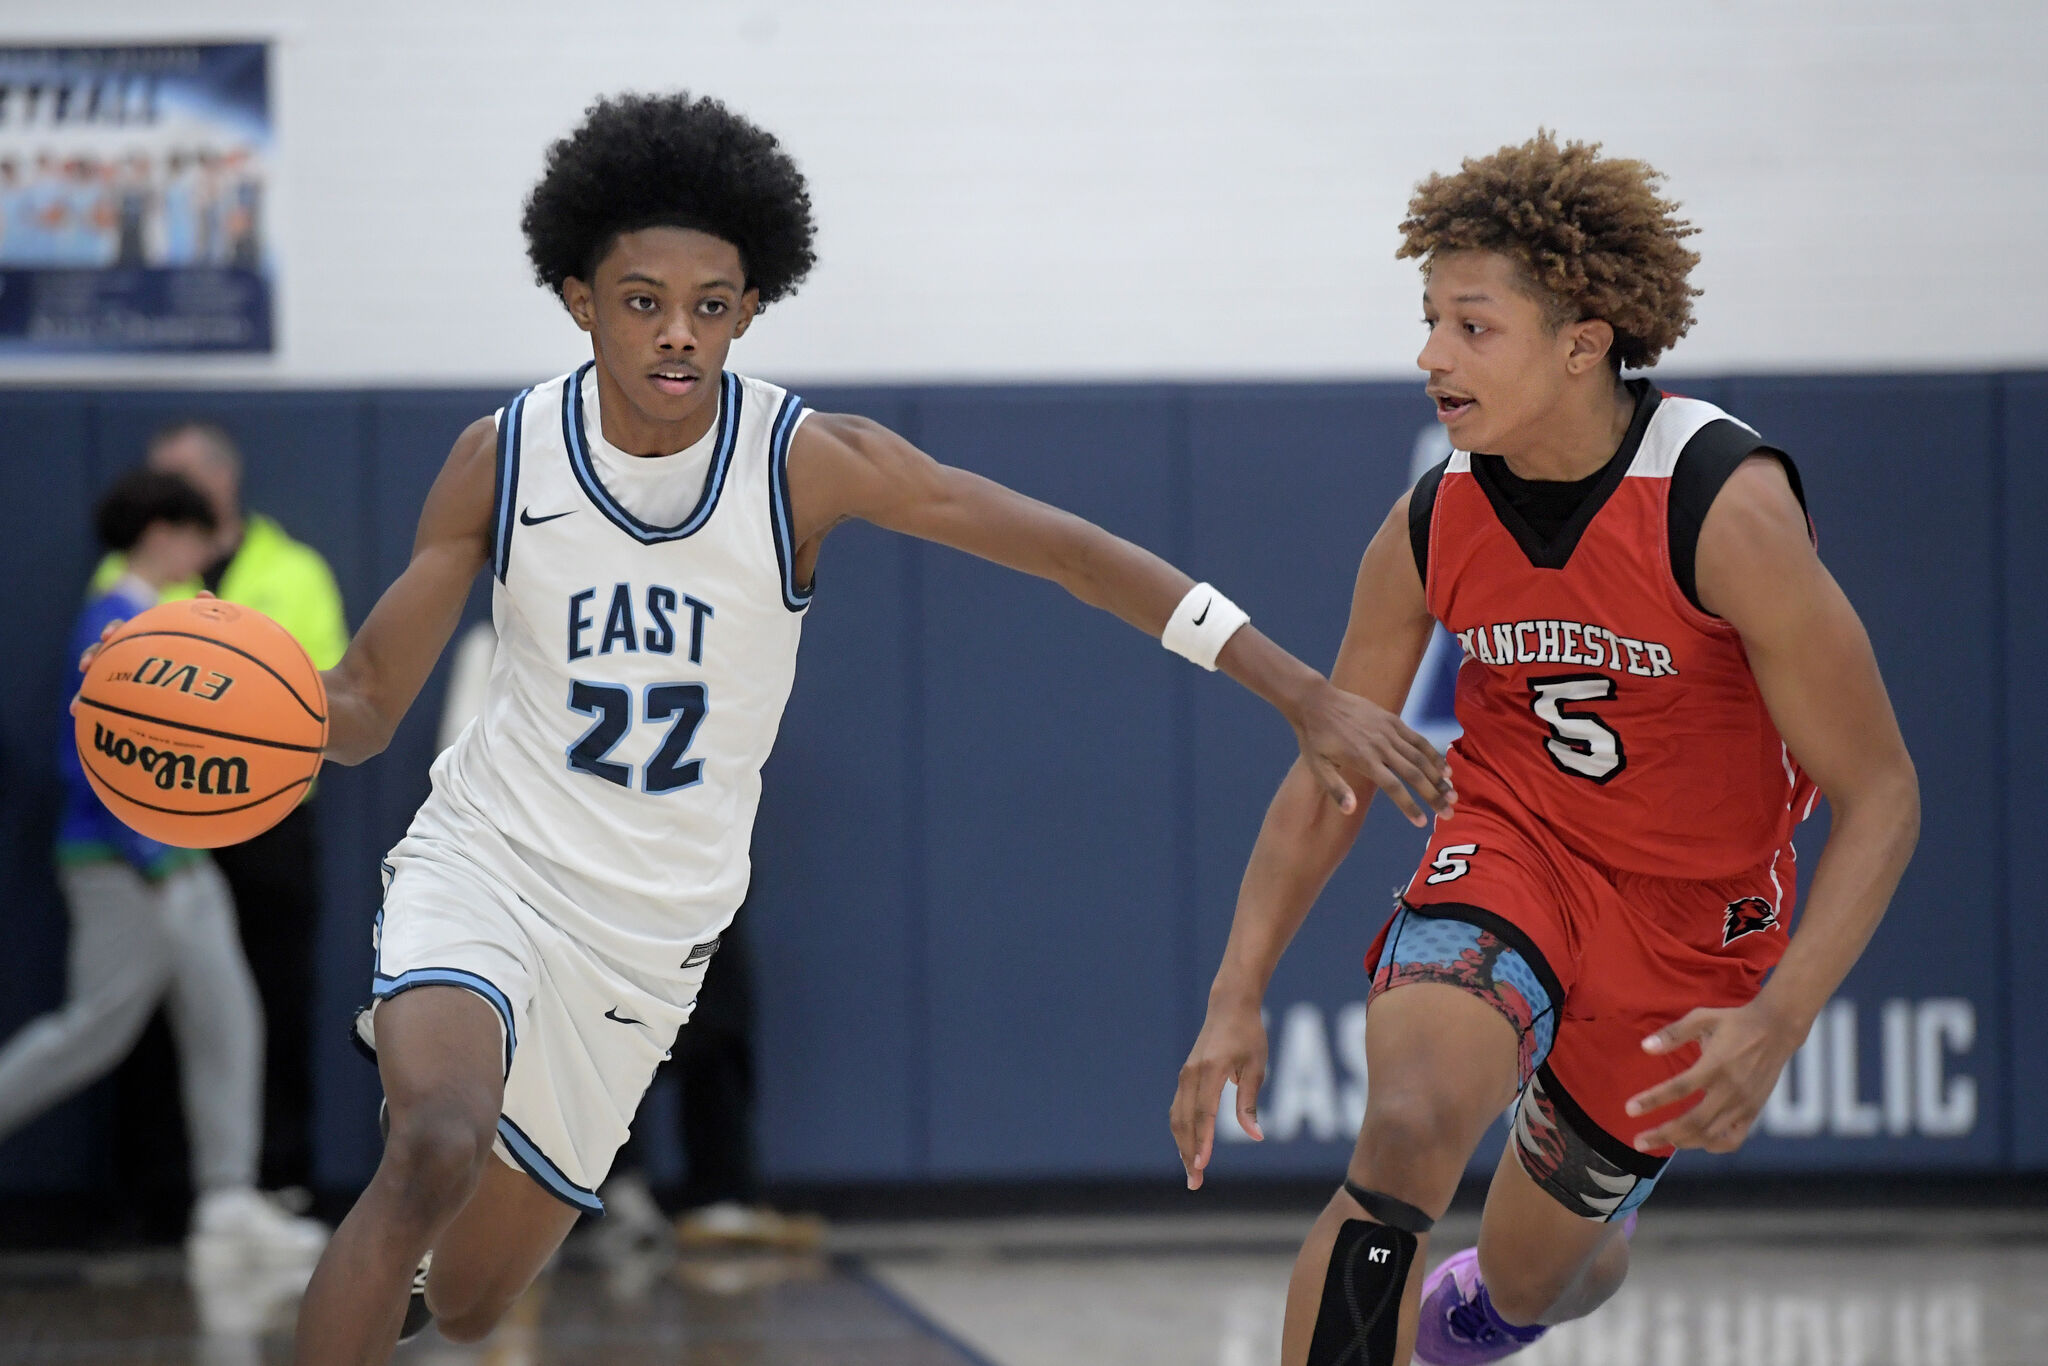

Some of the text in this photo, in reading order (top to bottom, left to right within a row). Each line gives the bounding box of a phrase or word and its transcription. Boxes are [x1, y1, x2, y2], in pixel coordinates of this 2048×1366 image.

[567, 581, 714, 666] EAST
[105, 656, 234, 701] EVO NXT
[94, 721, 251, 795] Wilson
[565, 678, 709, 796] 22
[1526, 672, 1627, 786] 5
[1425, 844, 1480, 886] 5
[1748, 997, 1978, 1138] OLIC
[1368, 1246, 1392, 1264] KT
